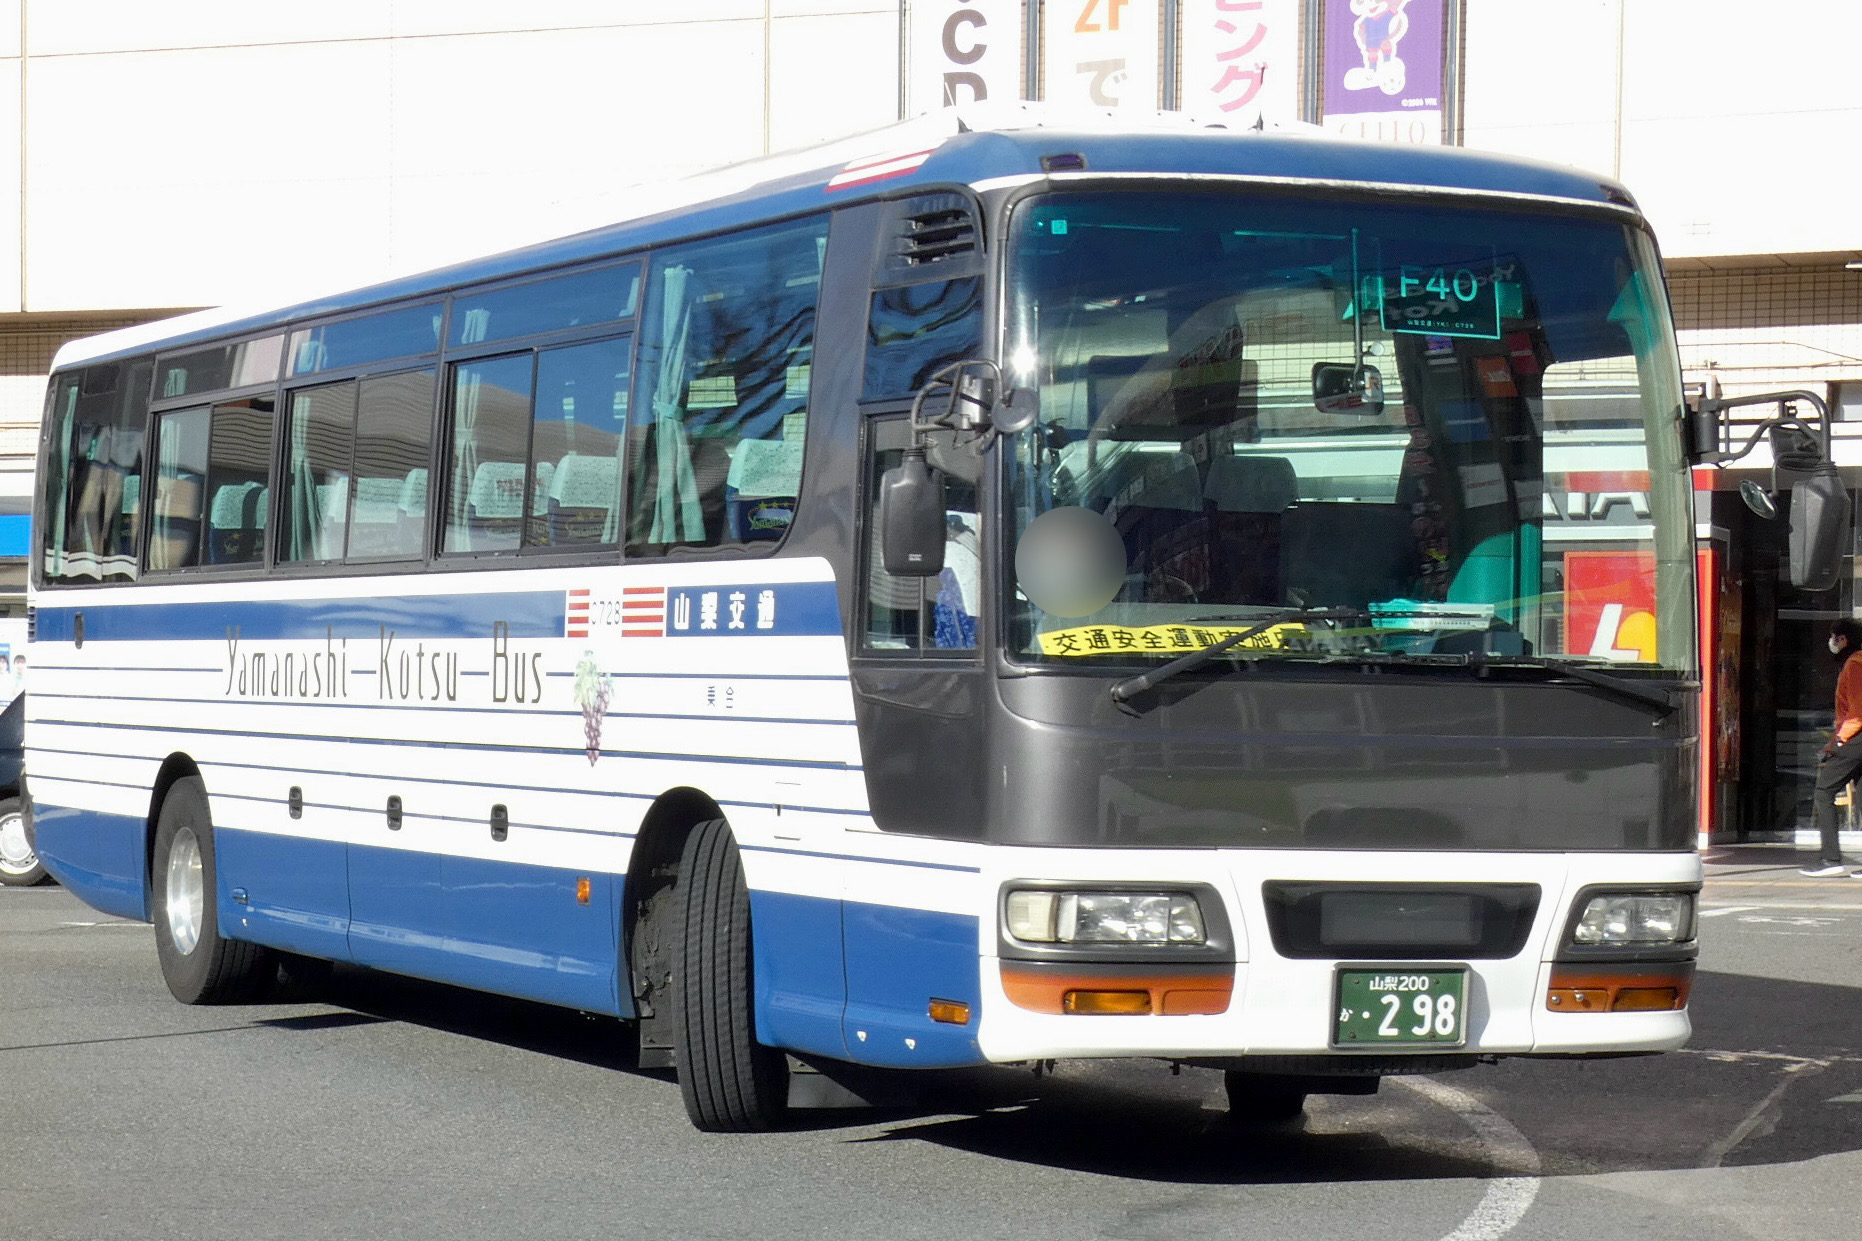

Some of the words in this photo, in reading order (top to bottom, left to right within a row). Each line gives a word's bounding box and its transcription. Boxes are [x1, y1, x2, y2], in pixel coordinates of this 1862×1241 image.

[1209, 0, 1269, 113] ング
[1400, 264, 1478, 302] F40
[674, 589, 775, 630] 山梨交通
[225, 625, 349, 697] Yamanashi
[380, 622, 457, 704] Kotsu
[492, 620, 544, 705] Bus
